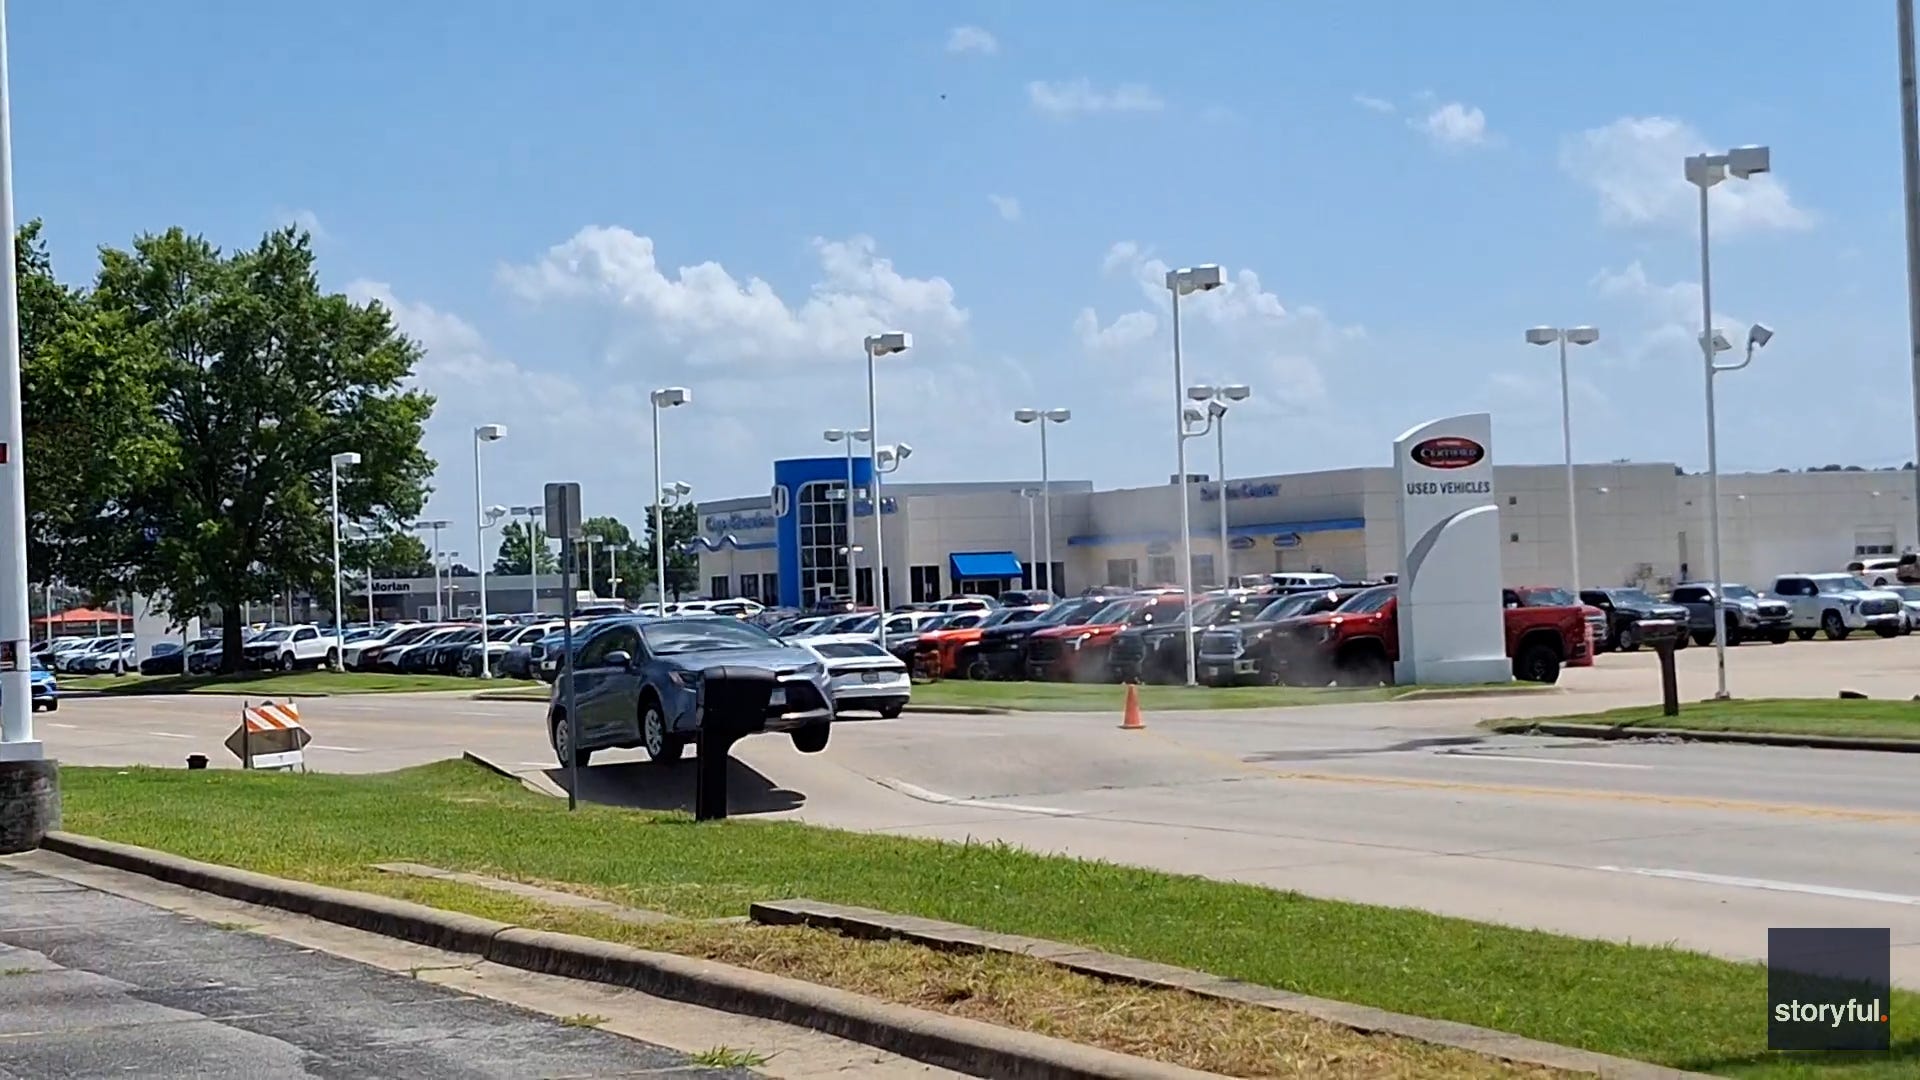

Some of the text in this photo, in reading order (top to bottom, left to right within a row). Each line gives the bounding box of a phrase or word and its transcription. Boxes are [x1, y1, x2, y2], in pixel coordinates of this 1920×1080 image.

[1407, 481, 1490, 495] USED VEHICLES
[371, 582, 410, 592] Morlan
